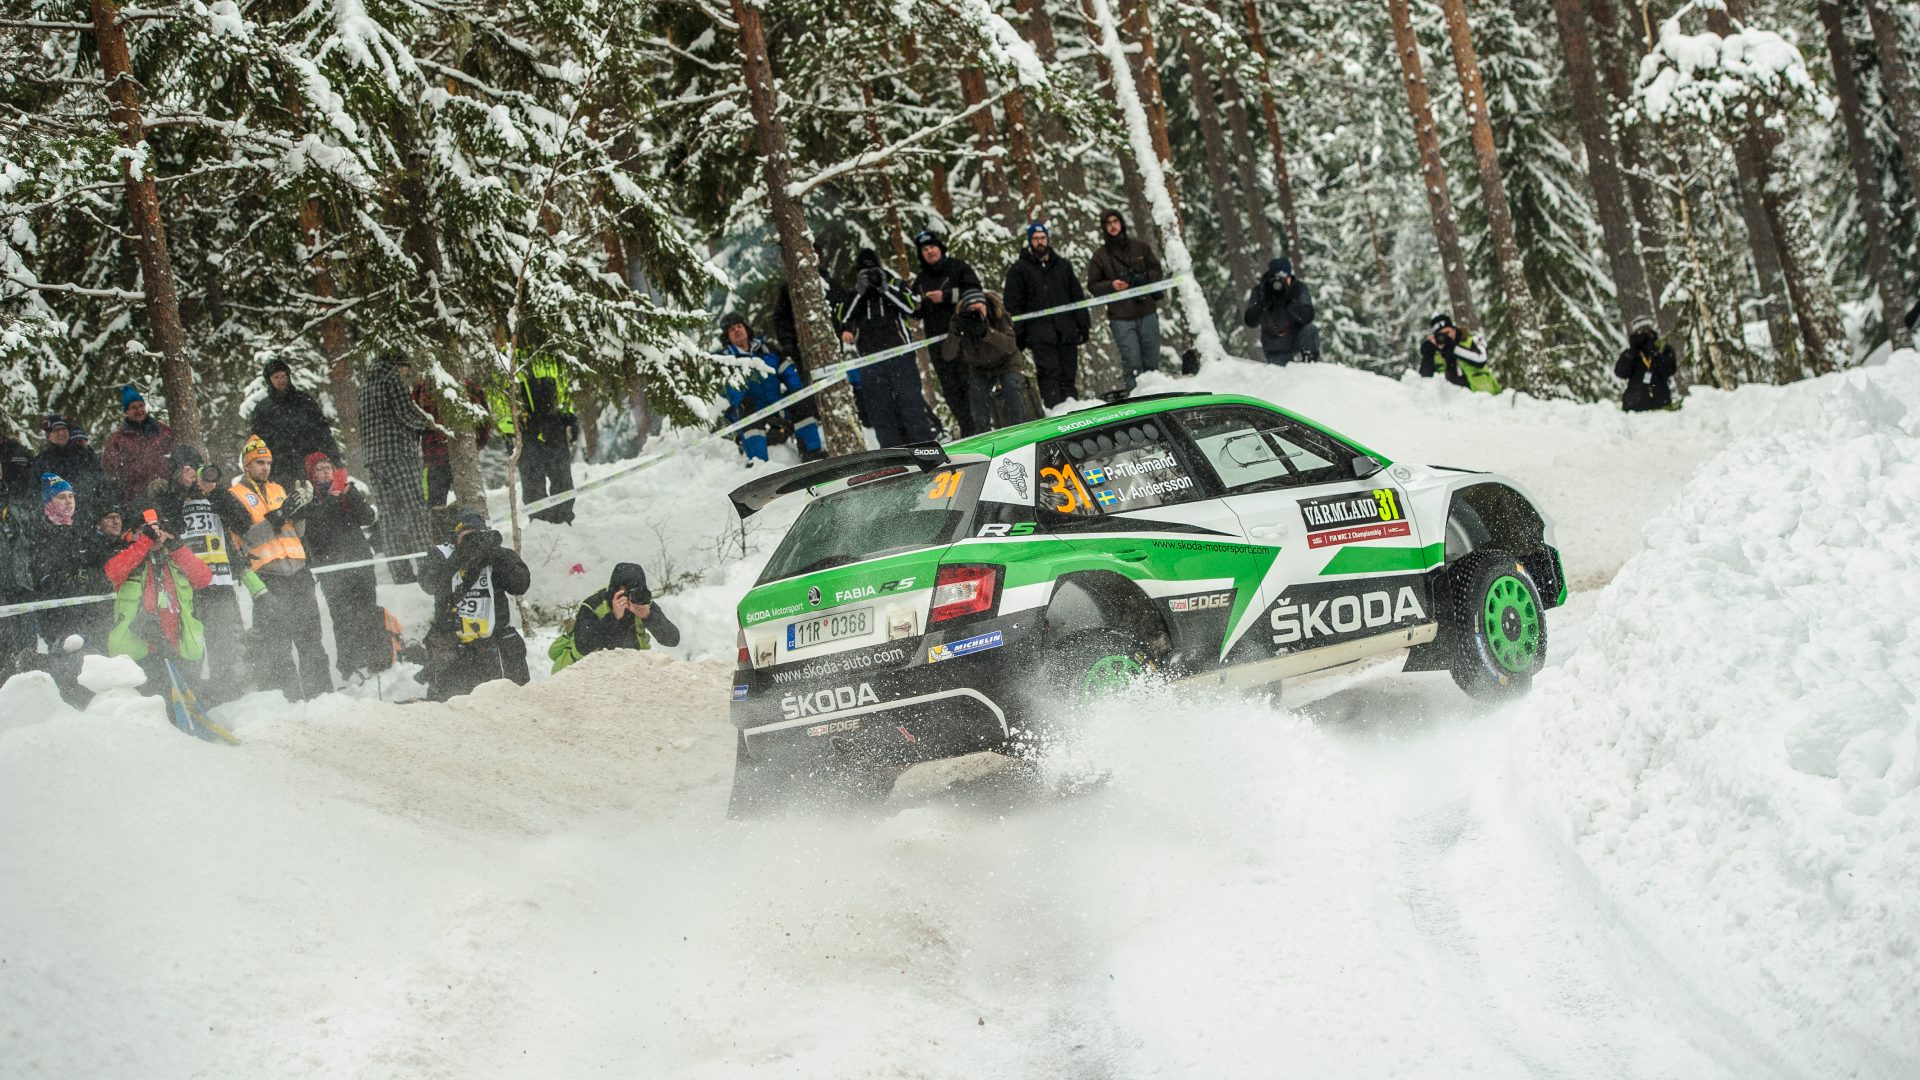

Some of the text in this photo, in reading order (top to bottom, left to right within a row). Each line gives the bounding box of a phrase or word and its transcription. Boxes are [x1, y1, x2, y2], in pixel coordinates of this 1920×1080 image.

[1057, 419, 1094, 433] ŠKODA
[1120, 408, 1136, 417] Parts
[914, 448, 940, 456] ŠKODA
[1116, 452, 1177, 477] Tidemand
[928, 469, 964, 499] 31
[1040, 463, 1092, 513] 31
[1117, 476, 1193, 502] J. Andersson
[1303, 487, 1399, 525] VÄRMLAND 31
[977, 522, 1037, 537] R5
[1152, 540, 1269, 555] www.skoda-motorsport.com
[835, 576, 917, 602] FABIA R5
[1189, 592, 1230, 611] EDGE
[746, 603, 804, 624] ŠKODA Motorsport
[1270, 586, 1426, 644] ŠKODA
[798, 612, 866, 644] 11R 0368
[788, 640, 795, 648] CZ
[954, 634, 1001, 652] MICHELIN
[781, 682, 880, 720] ŠKODA
